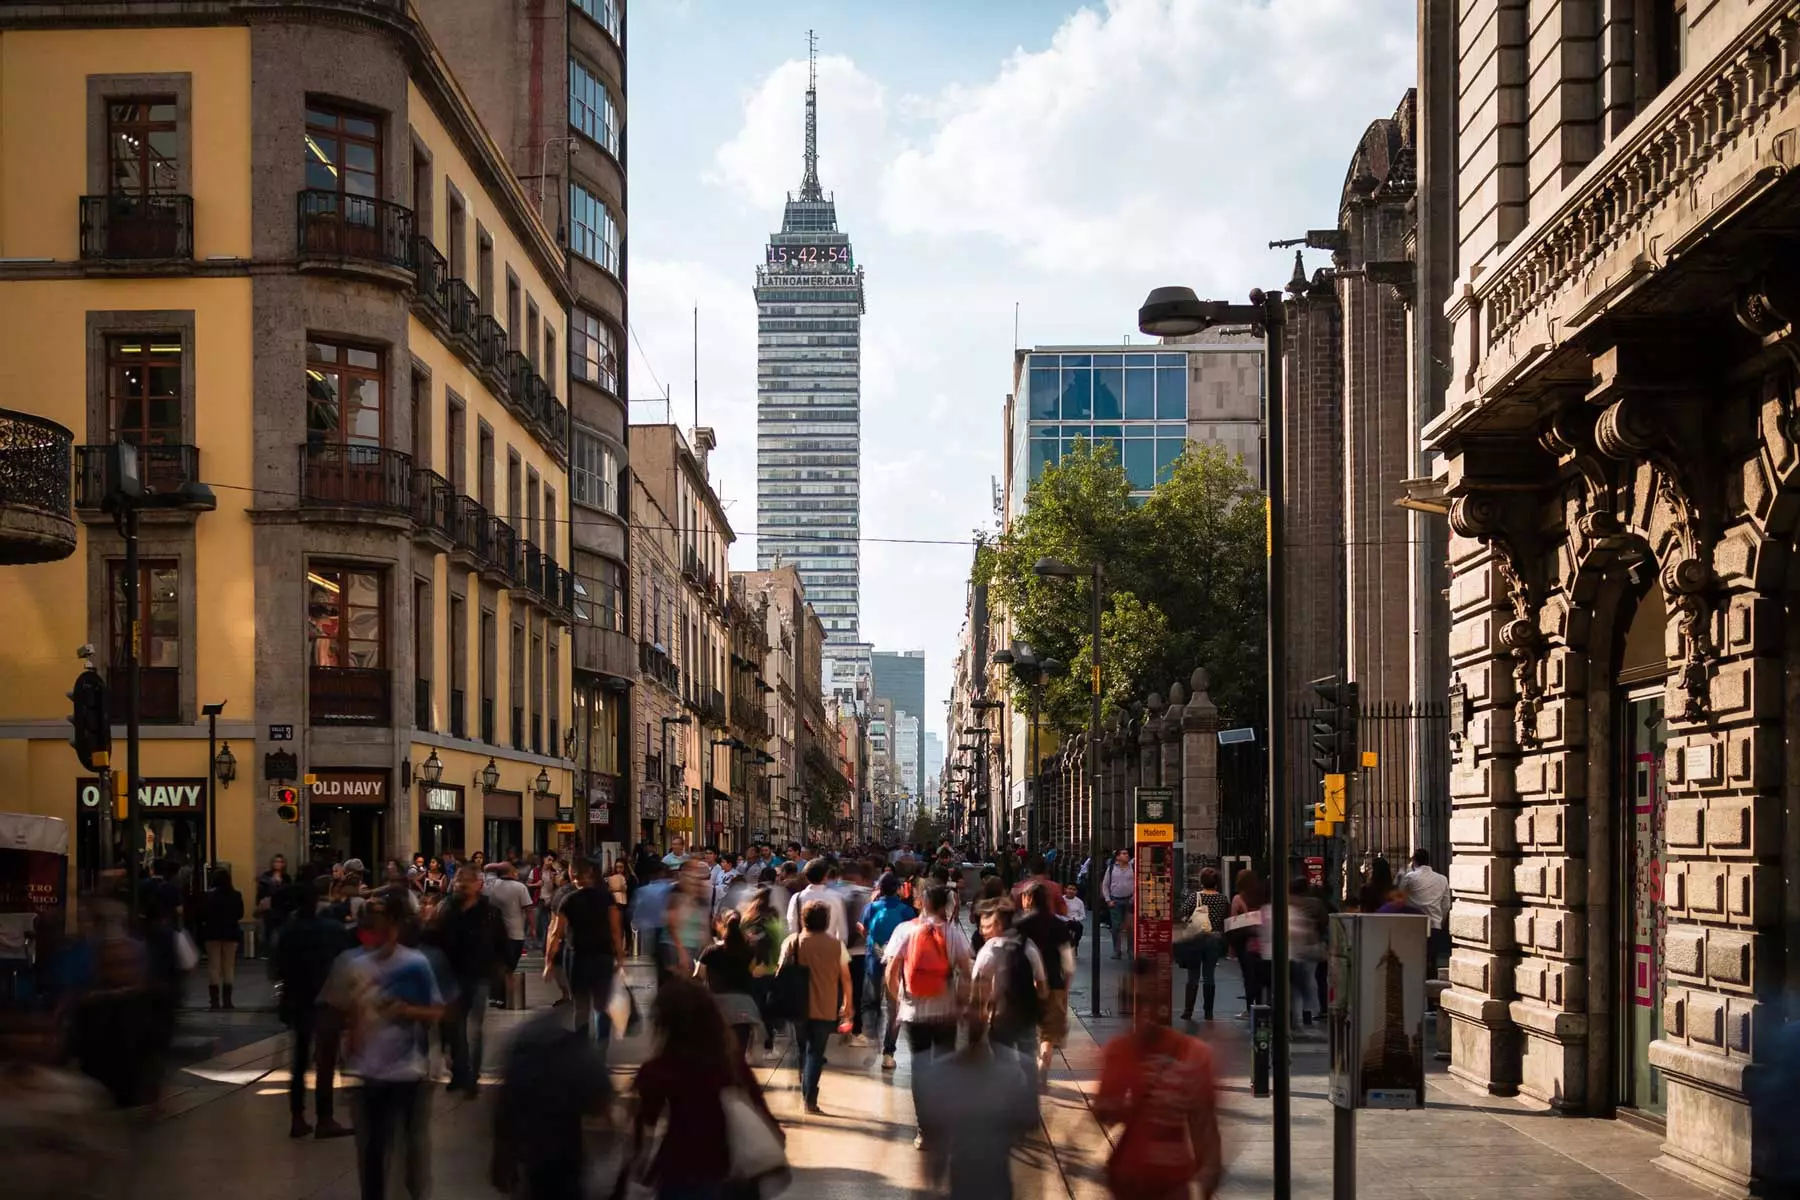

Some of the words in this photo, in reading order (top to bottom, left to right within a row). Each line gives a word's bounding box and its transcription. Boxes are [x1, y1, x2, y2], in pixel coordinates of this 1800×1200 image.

[769, 246, 848, 262] 15:42:54
[762, 276, 854, 286] LATINOAMERICANA
[138, 785, 201, 807] NAVY
[312, 781, 341, 796] OLD
[344, 781, 382, 796] NAVY
[1144, 828, 1166, 837] Madero
